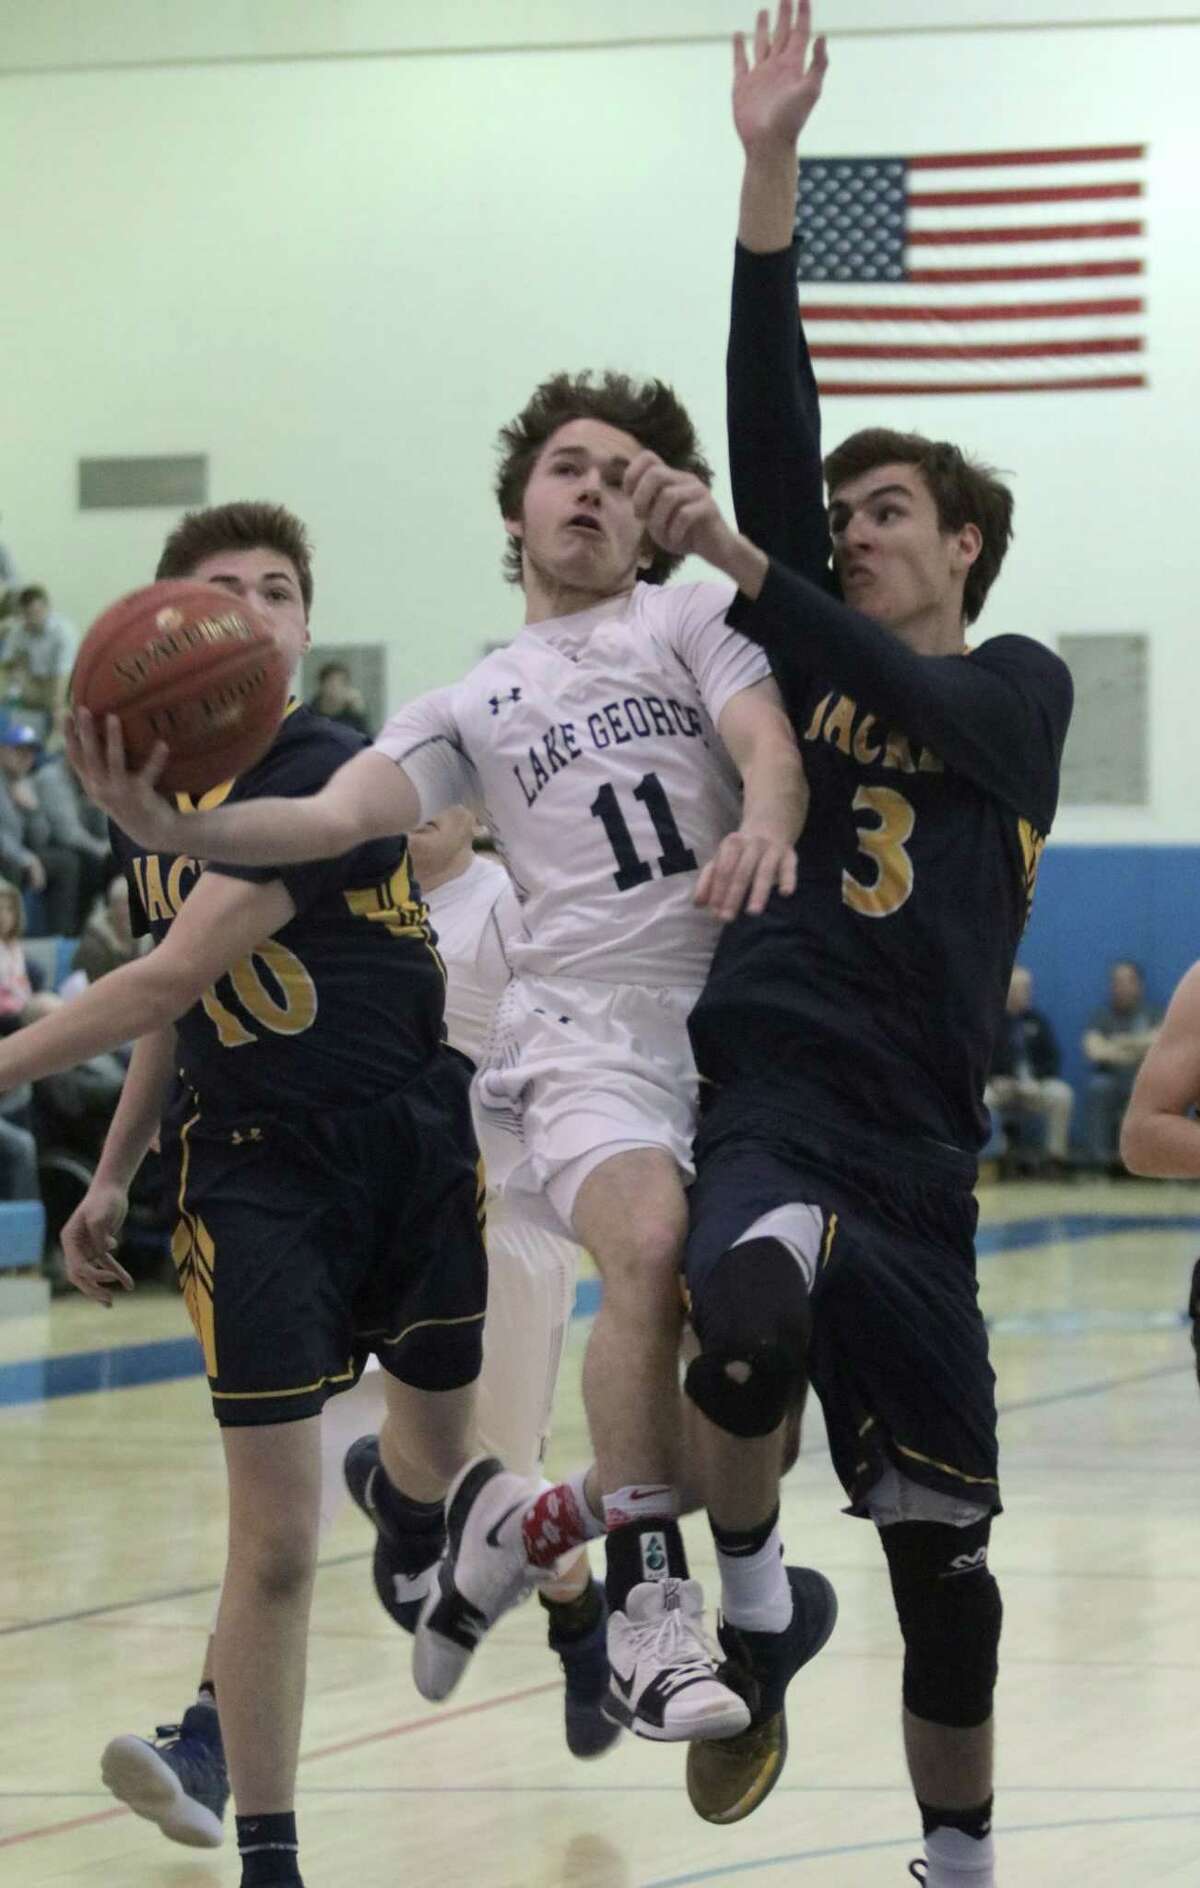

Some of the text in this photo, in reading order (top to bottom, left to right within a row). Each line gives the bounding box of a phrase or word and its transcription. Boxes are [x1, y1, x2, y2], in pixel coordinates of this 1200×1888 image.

[513, 723, 582, 808] LAKE
[589, 772, 698, 892] 11
[842, 784, 915, 917] 3
